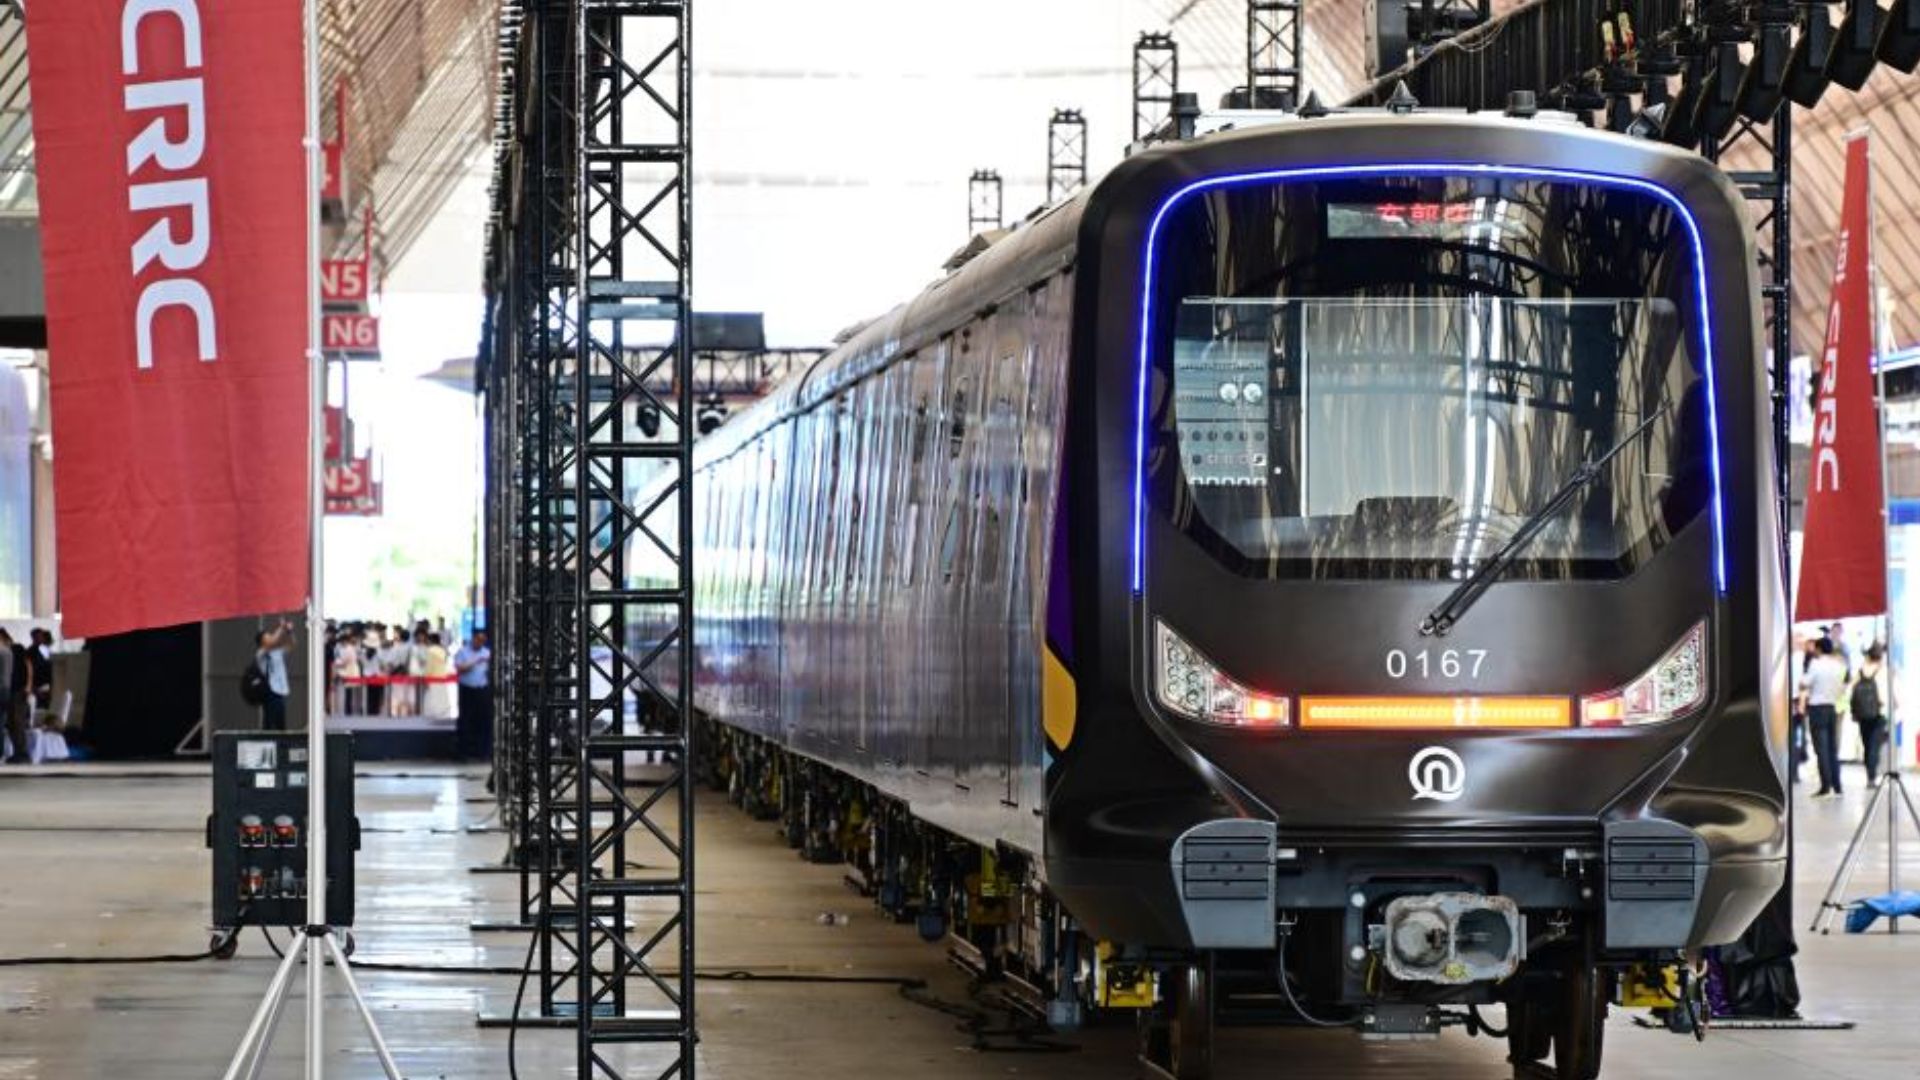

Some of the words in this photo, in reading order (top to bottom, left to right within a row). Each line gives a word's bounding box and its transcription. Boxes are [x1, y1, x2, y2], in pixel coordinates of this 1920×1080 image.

[121, 0, 218, 370] CRRC
[329, 317, 374, 346] N6
[1816, 300, 1841, 492] CRRC
[1386, 649, 1487, 678] 0167
